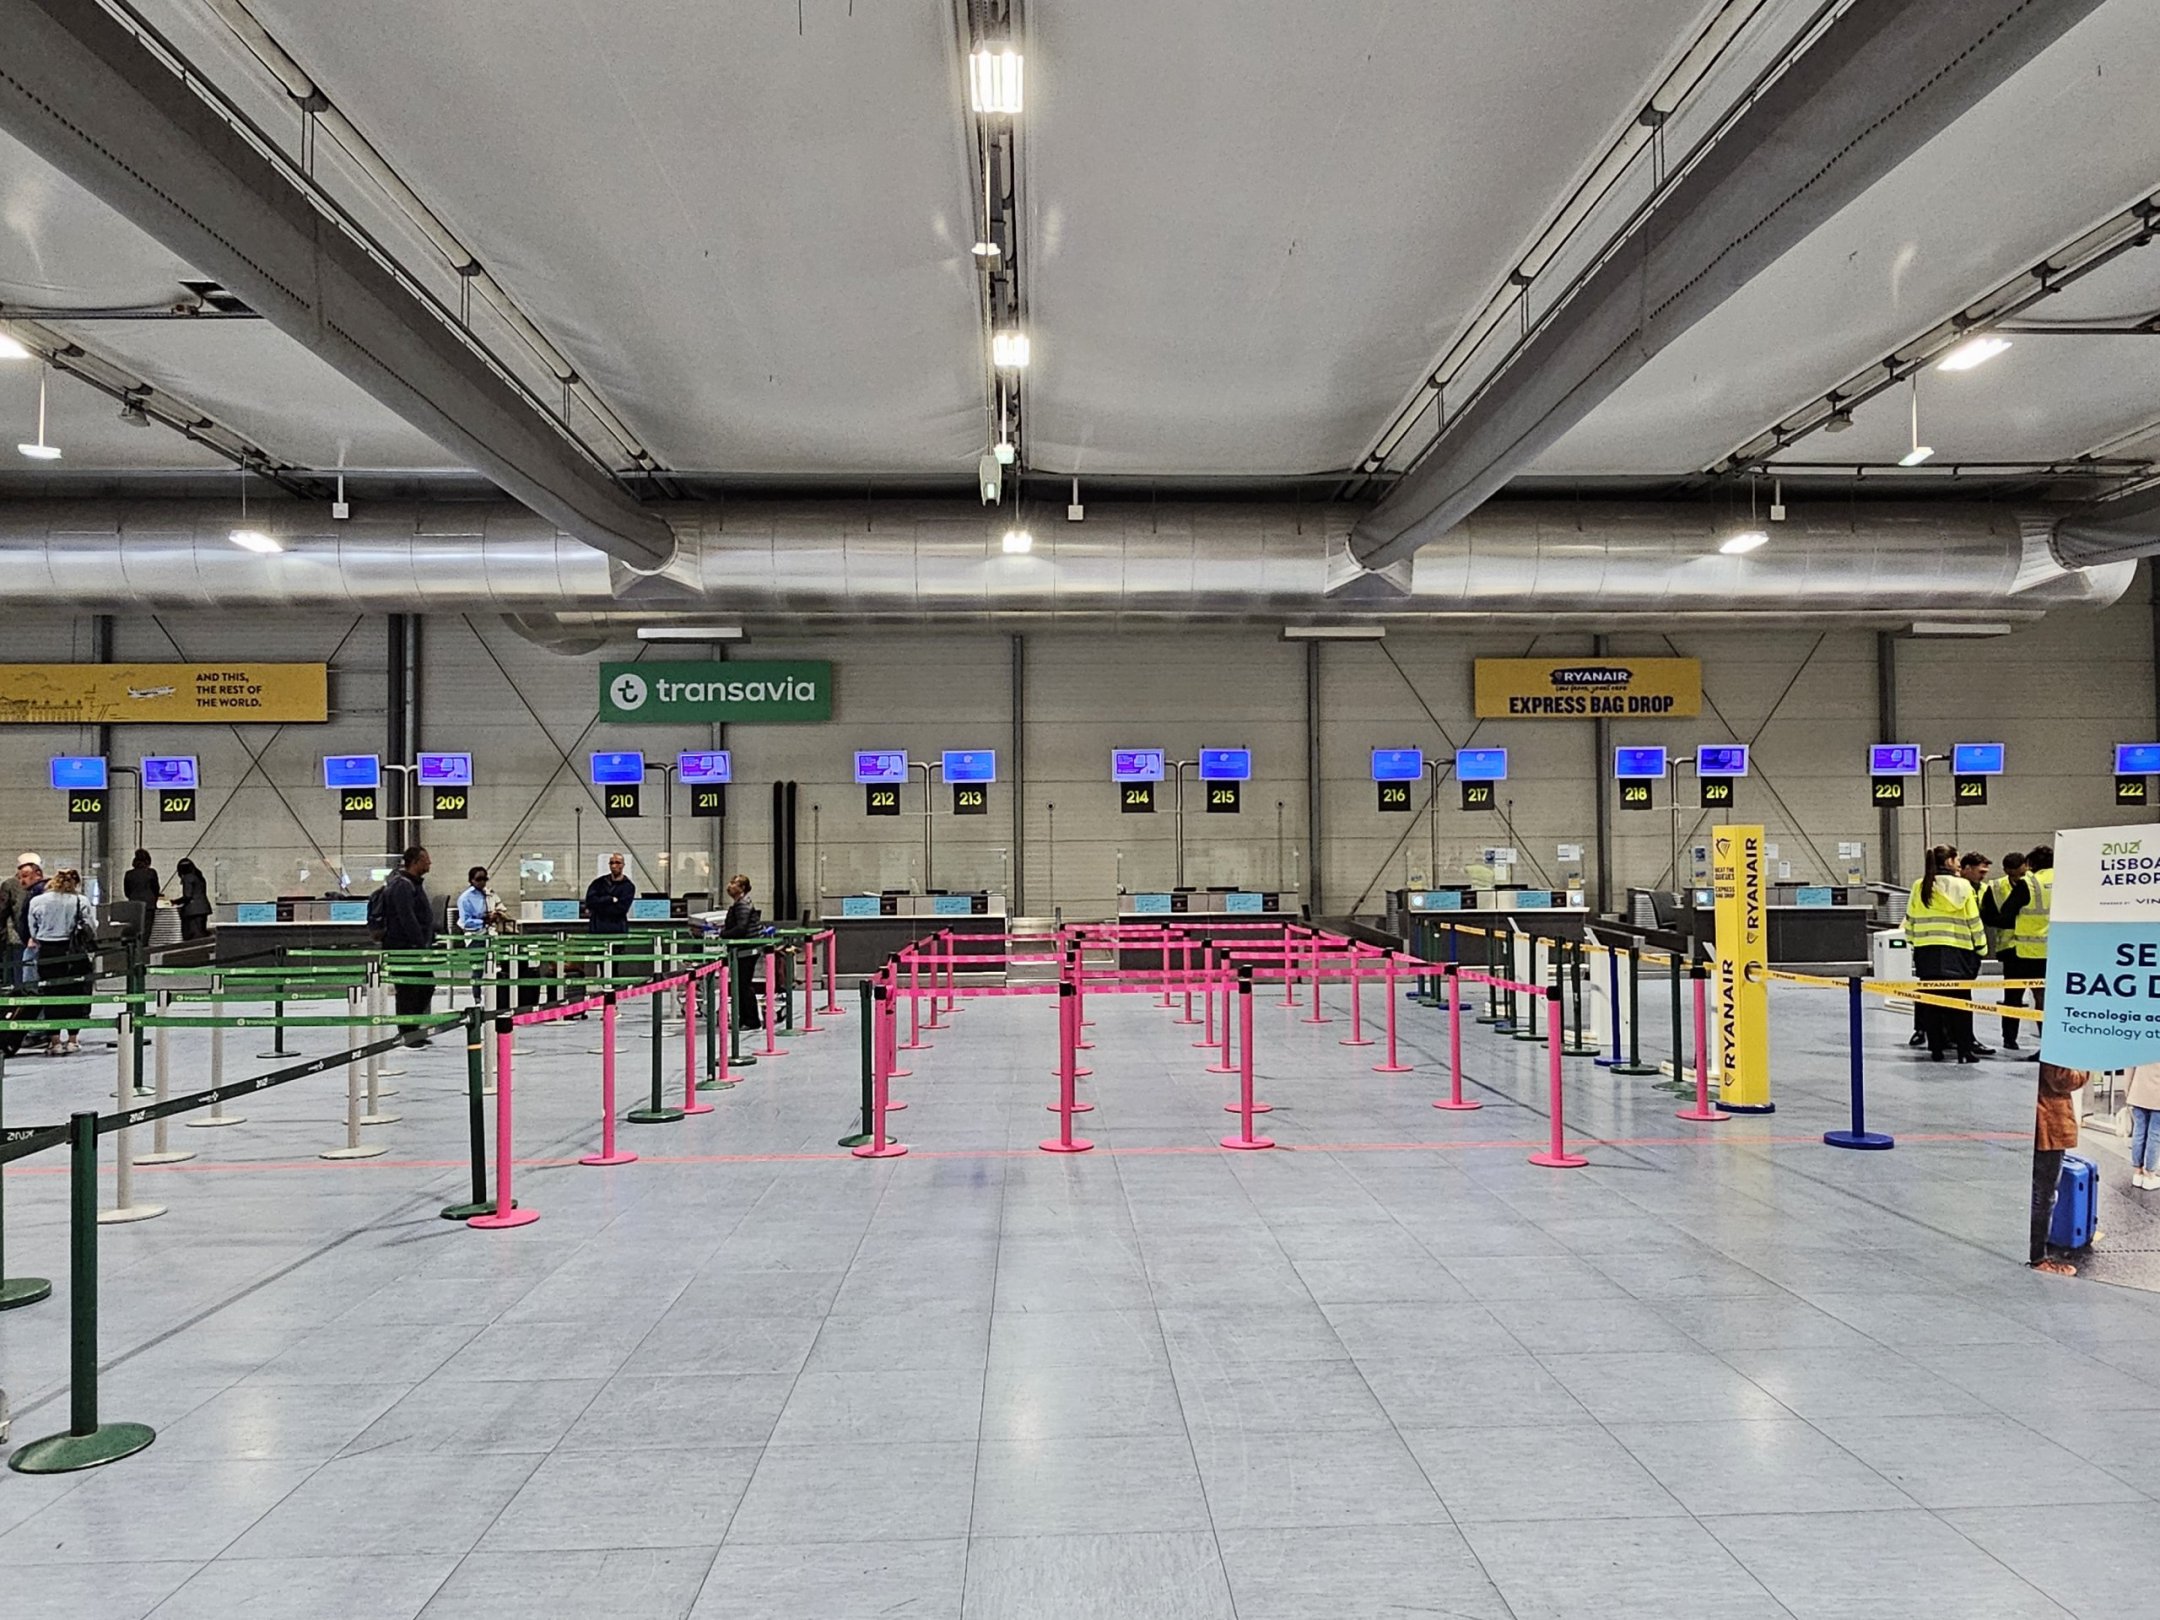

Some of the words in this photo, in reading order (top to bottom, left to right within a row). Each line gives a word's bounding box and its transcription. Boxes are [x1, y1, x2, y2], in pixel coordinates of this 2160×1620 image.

[196, 672, 220, 682] AND
[222, 672, 249, 683] THIS,
[1563, 671, 1629, 682] RYANAIR
[196, 685, 217, 695] THE
[220, 685, 244, 695] REST
[247, 685, 262, 695] OF
[656, 676, 815, 701] transavia
[196, 697, 217, 707] THE
[220, 697, 262, 707] WORLD.
[1509, 696, 1586, 714] EXPRESS
[1590, 696, 1624, 714] BAG
[1628, 695, 1674, 713] DROP
[1383, 789, 1406, 802] 216
[1468, 788, 1488, 802] 217
[1625, 787, 1648, 800] 218
[1706, 785, 1728, 799] 219
[1875, 784, 1901, 798] 220
[1960, 783, 1982, 796] 221
[2119, 783, 2144, 796] 222
[345, 797, 373, 811] 208
[436, 796, 465, 810] 209
[611, 794, 634, 808] 210
[699, 793, 718, 807] 211
[872, 792, 895, 806] 212
[960, 791, 982, 805] 213
[1126, 790, 1149, 804] 214
[1212, 790, 1235, 804] 215
[72, 799, 101, 812] 206
[163, 798, 191, 812] 207
[1745, 837, 1760, 929] RYANAIR
[2116, 943, 2158, 967] SE
[2066, 972, 2137, 998] BAG
[1722, 959, 1736, 1069] RYANAIR
[2064, 1006, 2141, 1023] Tecnologia
[2061, 1022, 2142, 1040] Technology
